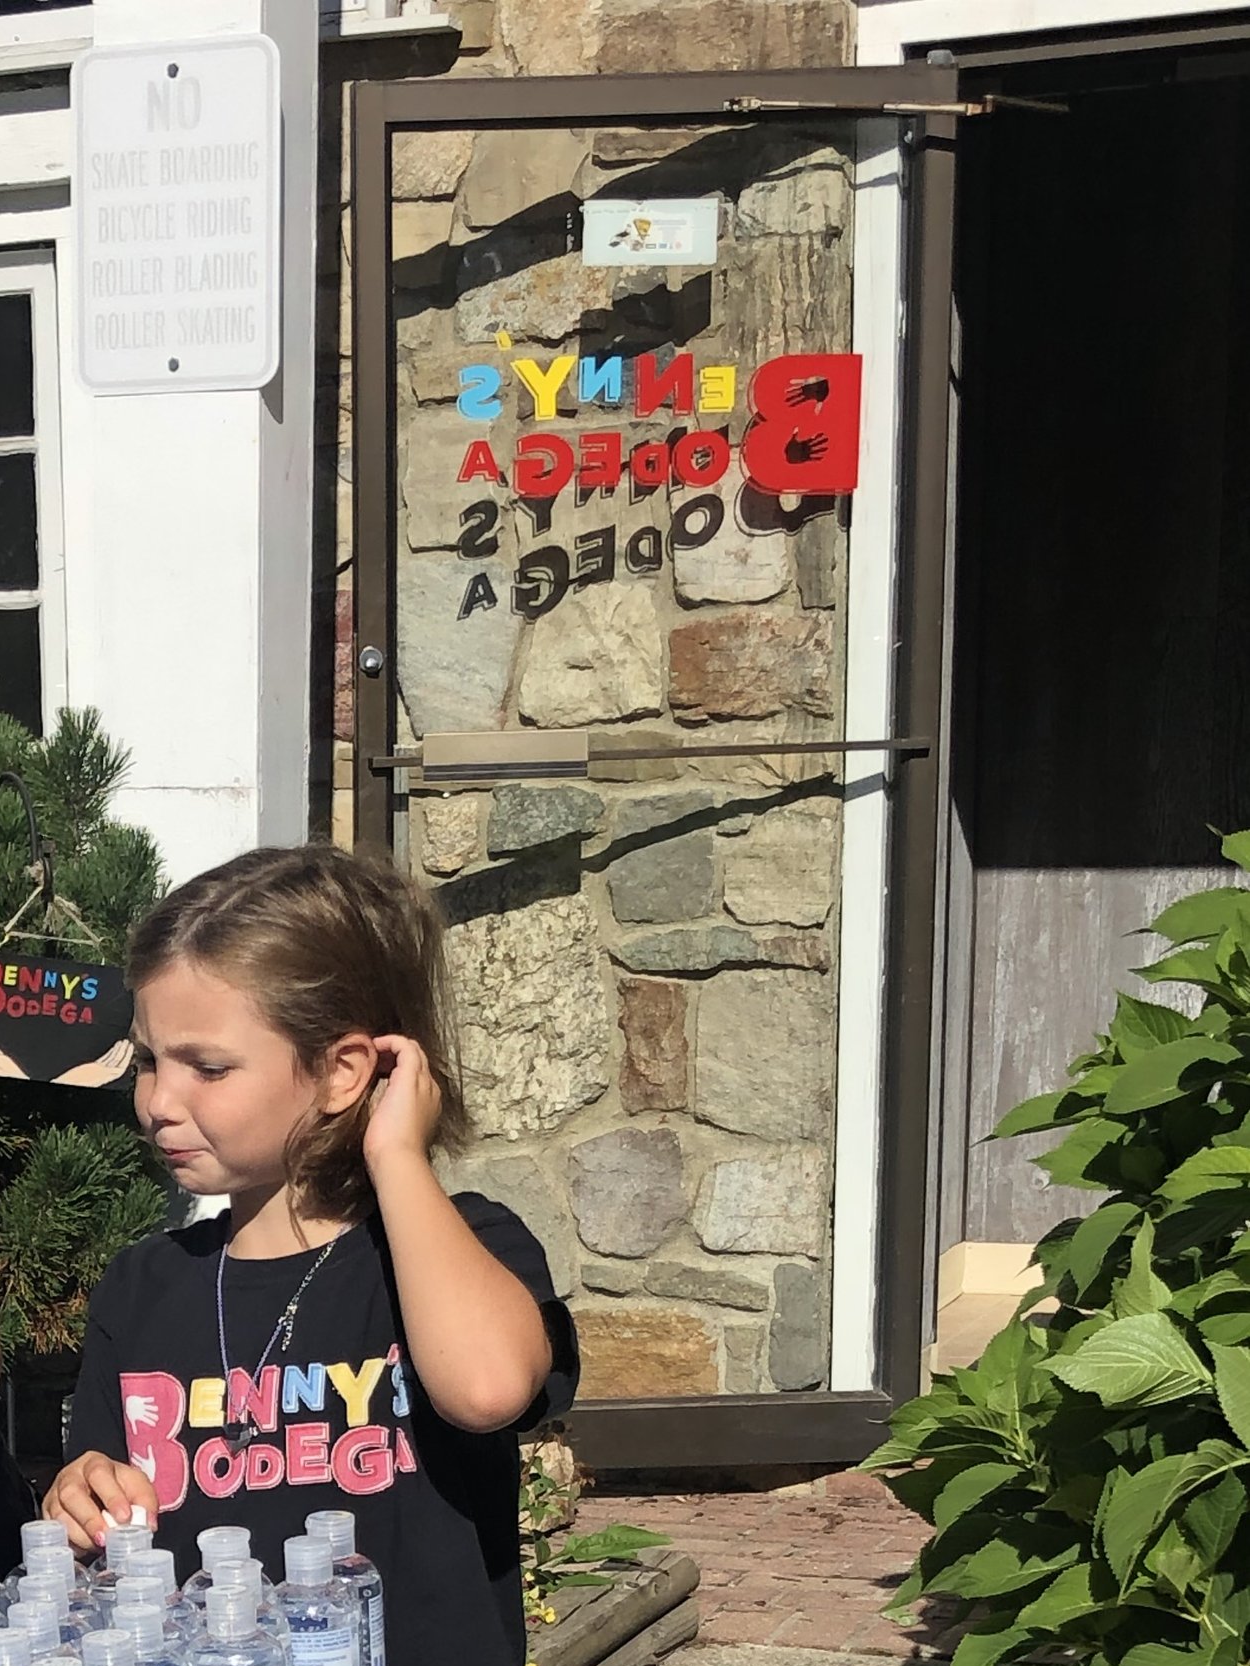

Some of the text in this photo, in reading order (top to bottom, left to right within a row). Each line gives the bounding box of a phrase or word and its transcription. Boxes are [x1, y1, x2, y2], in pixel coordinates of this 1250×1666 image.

[146, 76, 202, 133] NO
[92, 142, 259, 190] SKATE BOARDING
[98, 196, 252, 243] BICYCLE RIDING
[92, 251, 257, 297] ROLLER BLADING
[95, 305, 255, 350] ROLLER SKATING
